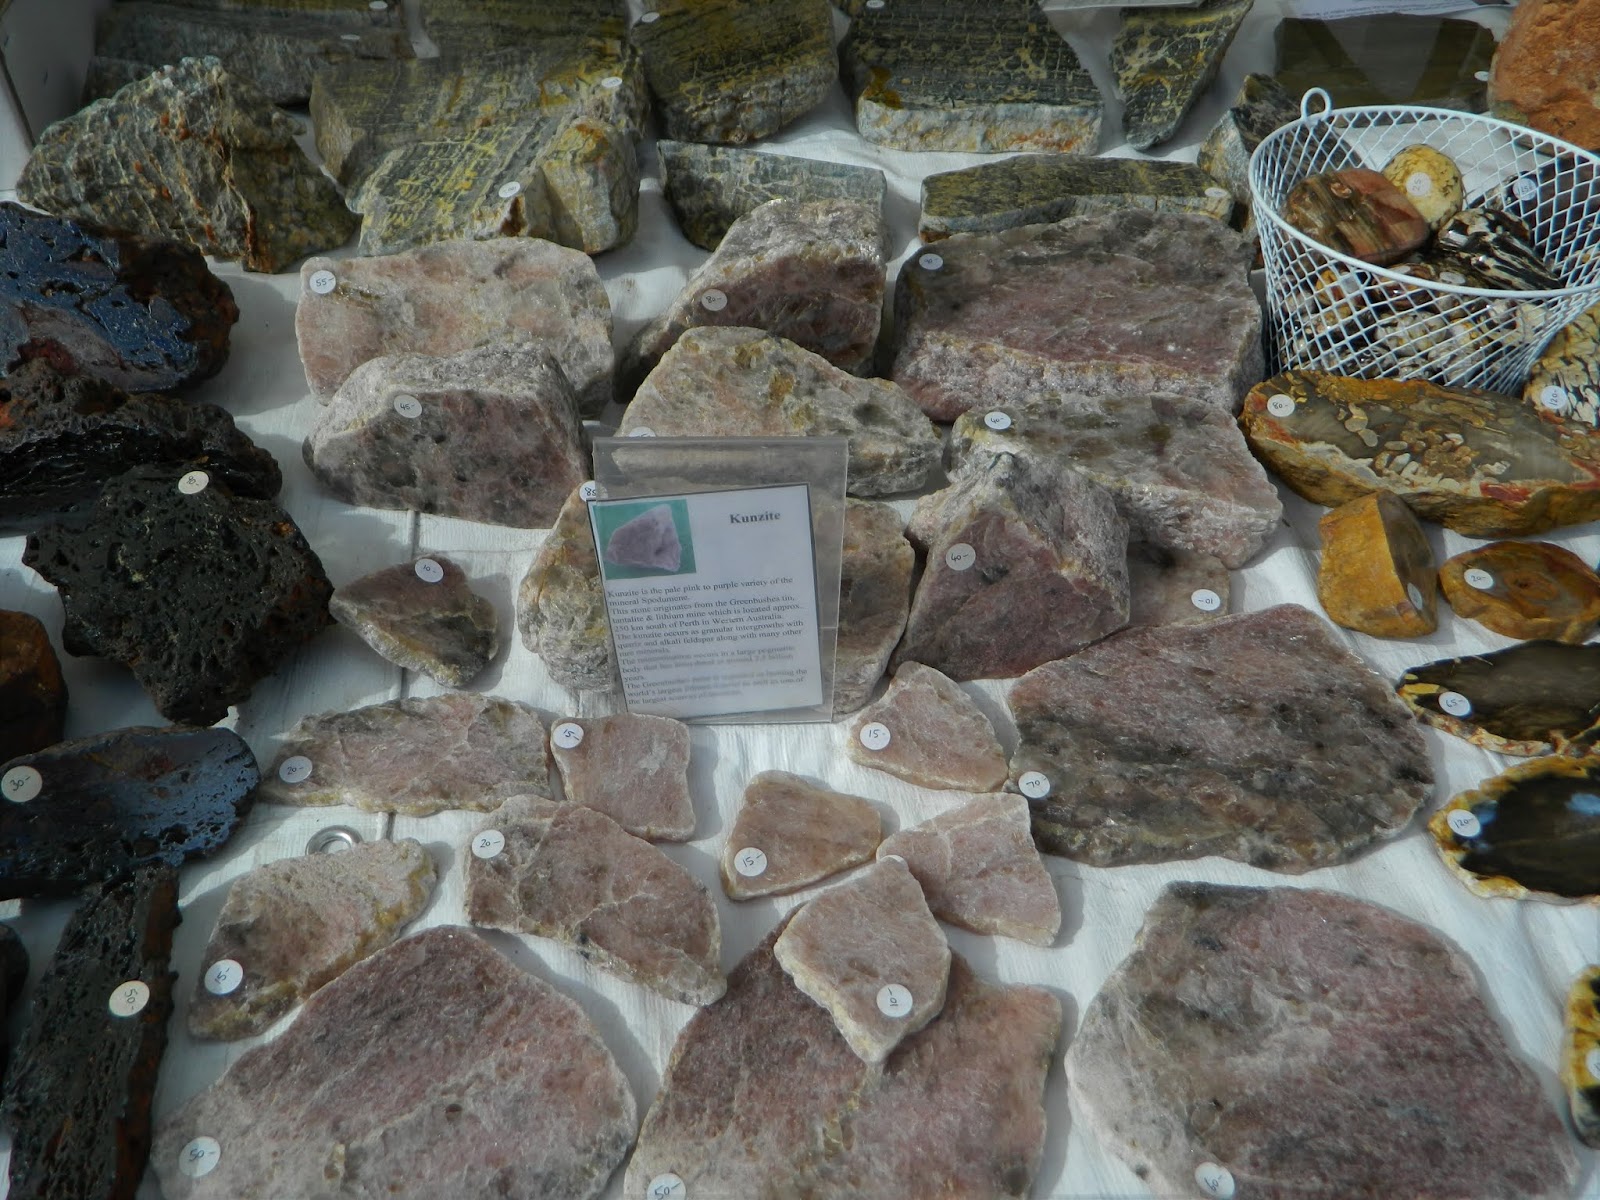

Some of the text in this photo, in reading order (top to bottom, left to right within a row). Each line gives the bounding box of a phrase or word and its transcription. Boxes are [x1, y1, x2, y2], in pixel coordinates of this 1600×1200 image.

[730, 511, 781, 524] Kunzite
[684, 584, 700, 592] pink
[714, 582, 738, 590] purple
[702, 626, 733, 636] granular
[736, 623, 784, 632] intergrowths
